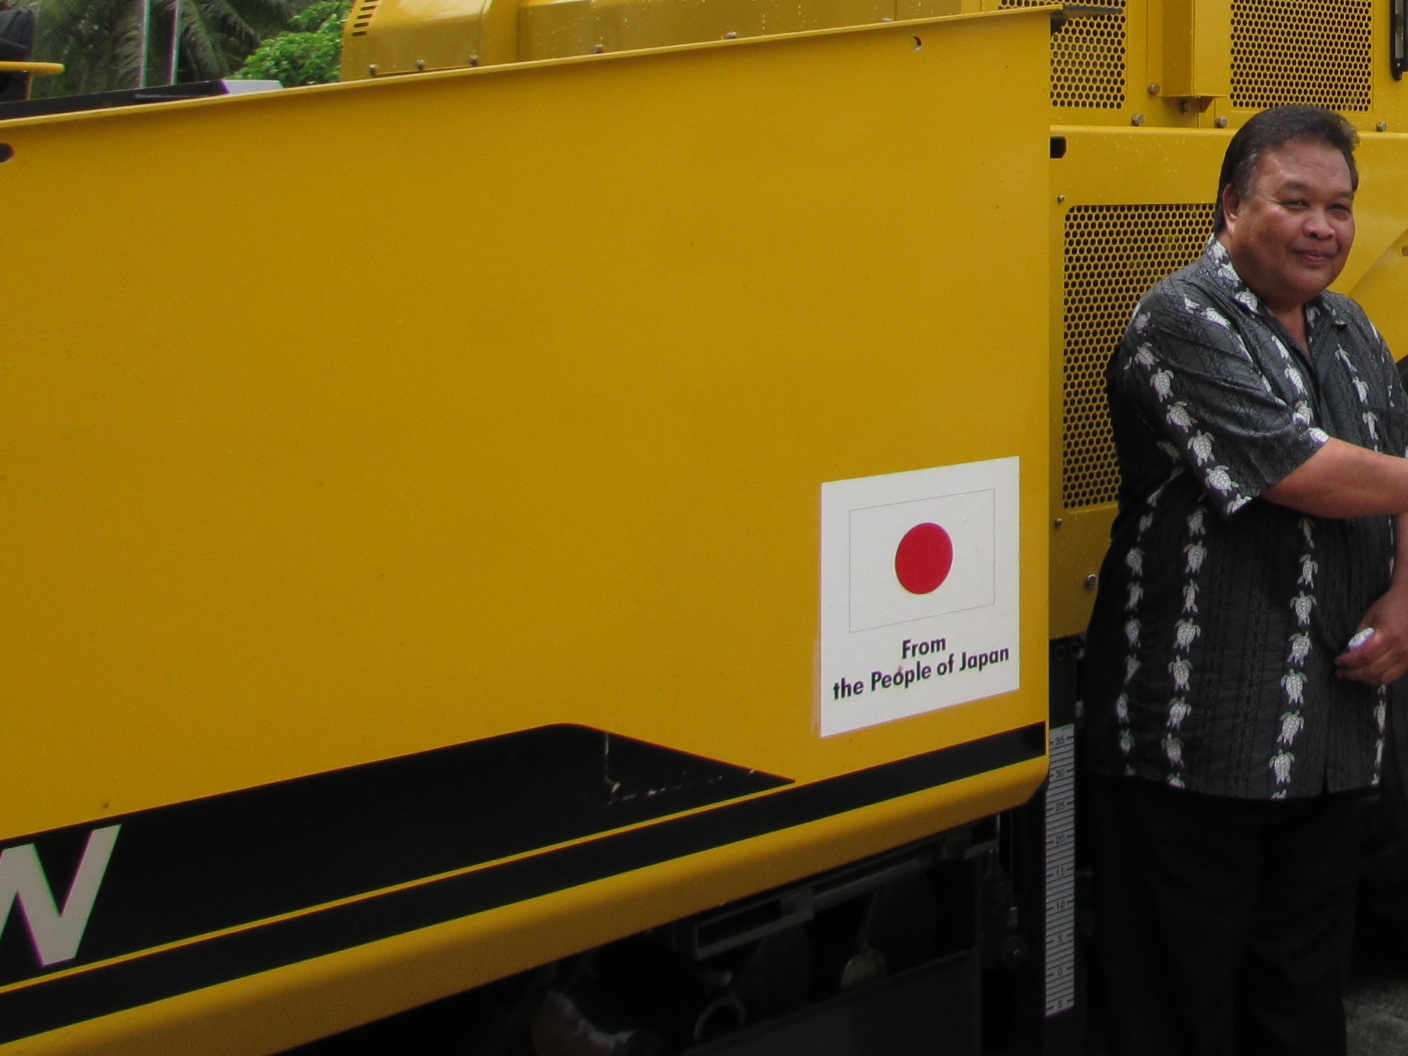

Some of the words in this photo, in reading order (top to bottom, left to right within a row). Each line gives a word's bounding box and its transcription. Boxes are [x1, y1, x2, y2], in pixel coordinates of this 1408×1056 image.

[901, 636, 947, 660] From
[832, 677, 865, 701] the
[870, 660, 932, 692] People
[936, 653, 954, 676] of
[958, 647, 1010, 672] Japan
[1056, 900, 1066, 910] 10
